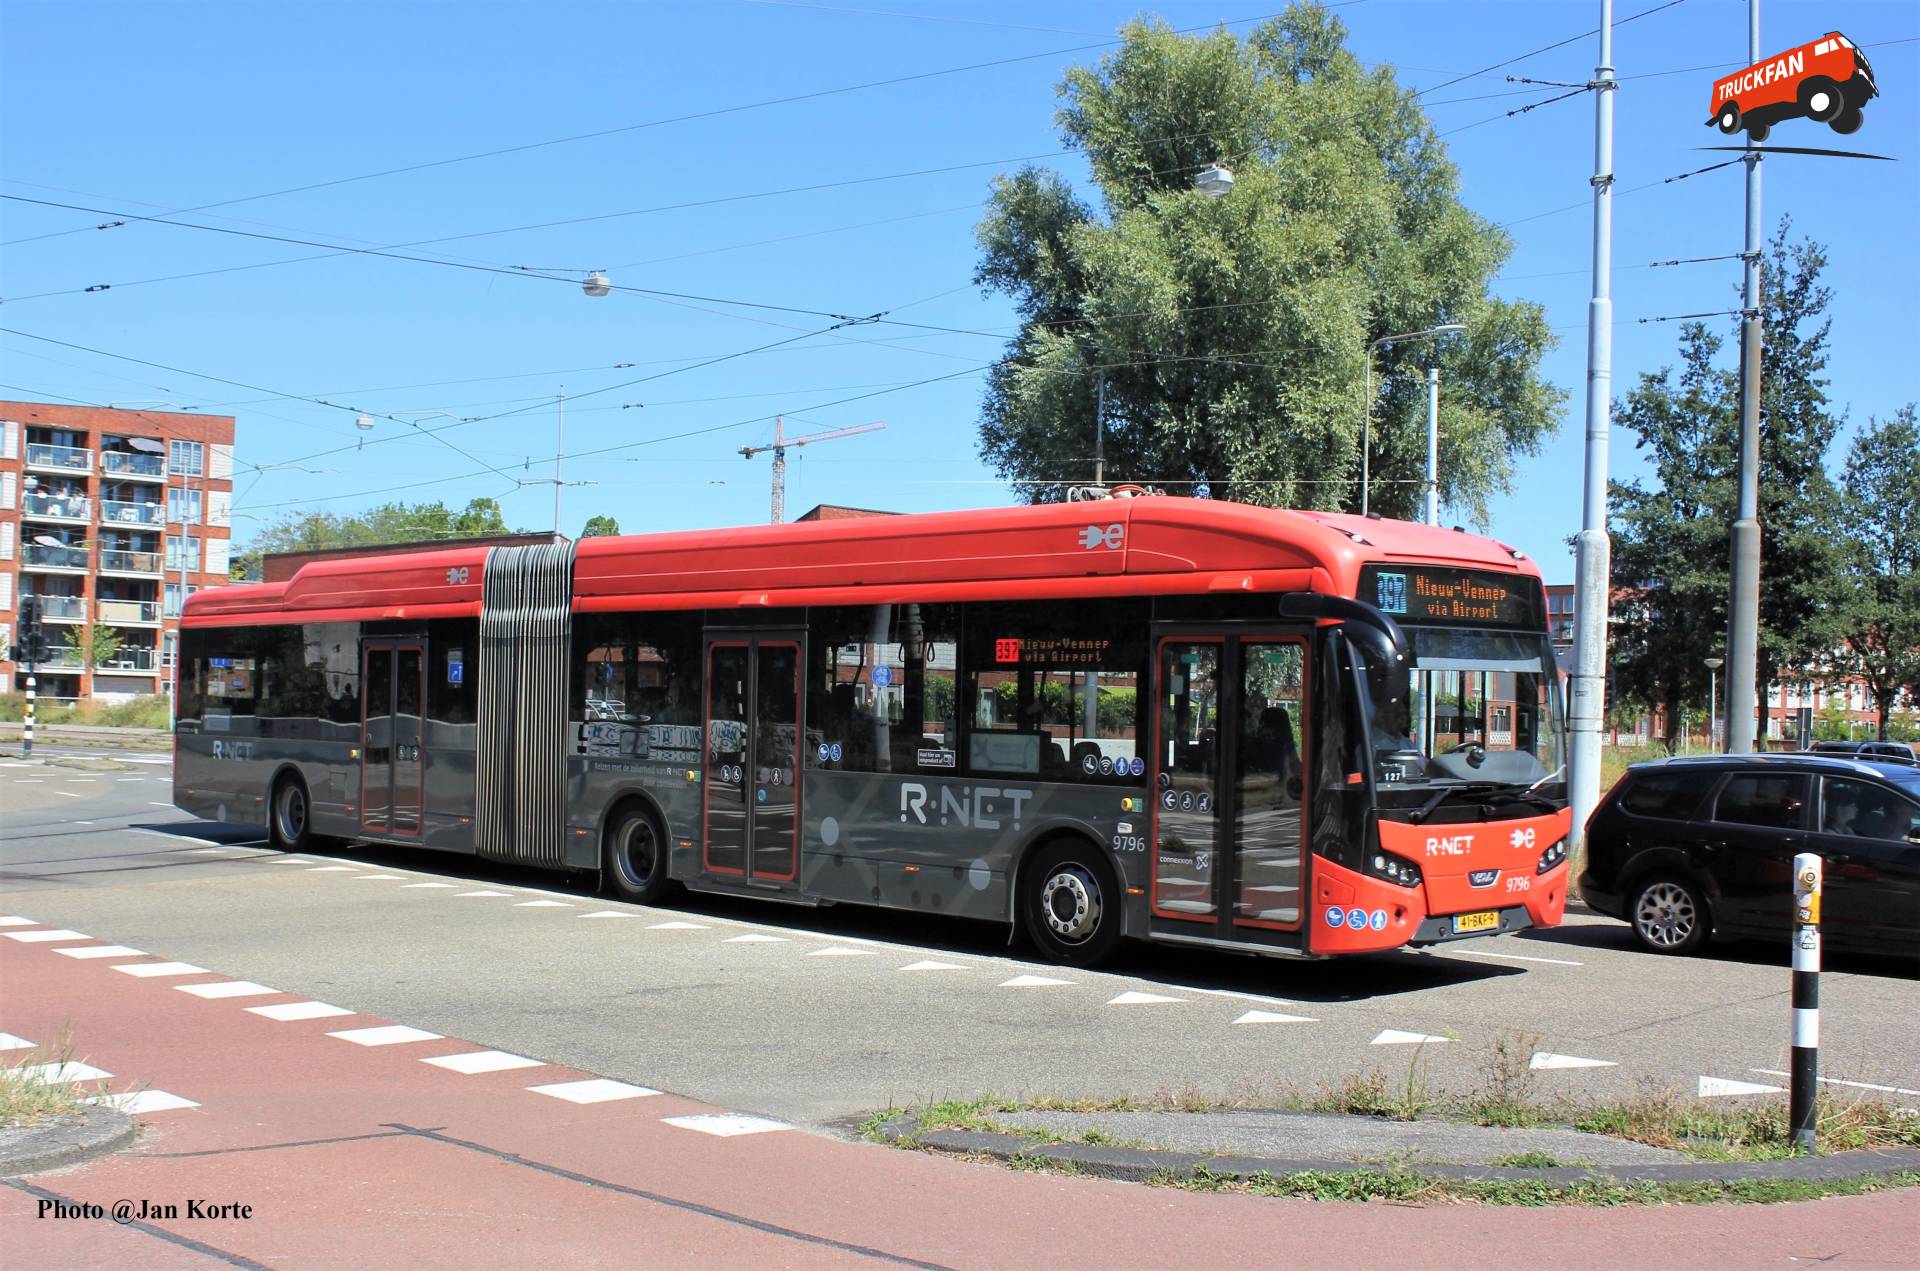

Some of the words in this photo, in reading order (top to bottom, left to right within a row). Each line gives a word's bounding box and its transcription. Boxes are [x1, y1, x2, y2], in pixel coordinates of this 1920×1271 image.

[1416, 575, 1506, 600] Nieuw-Vennep
[1427, 600, 1448, 616] via
[1452, 600, 1499, 618] Airport
[997, 641, 1018, 660] 397
[1019, 638, 1109, 649] Nieuw-Vennep
[1025, 651, 1045, 662] via
[1051, 651, 1102, 662] Airport
[1113, 835, 1145, 852] 9796
[1506, 876, 1530, 893] 9796
